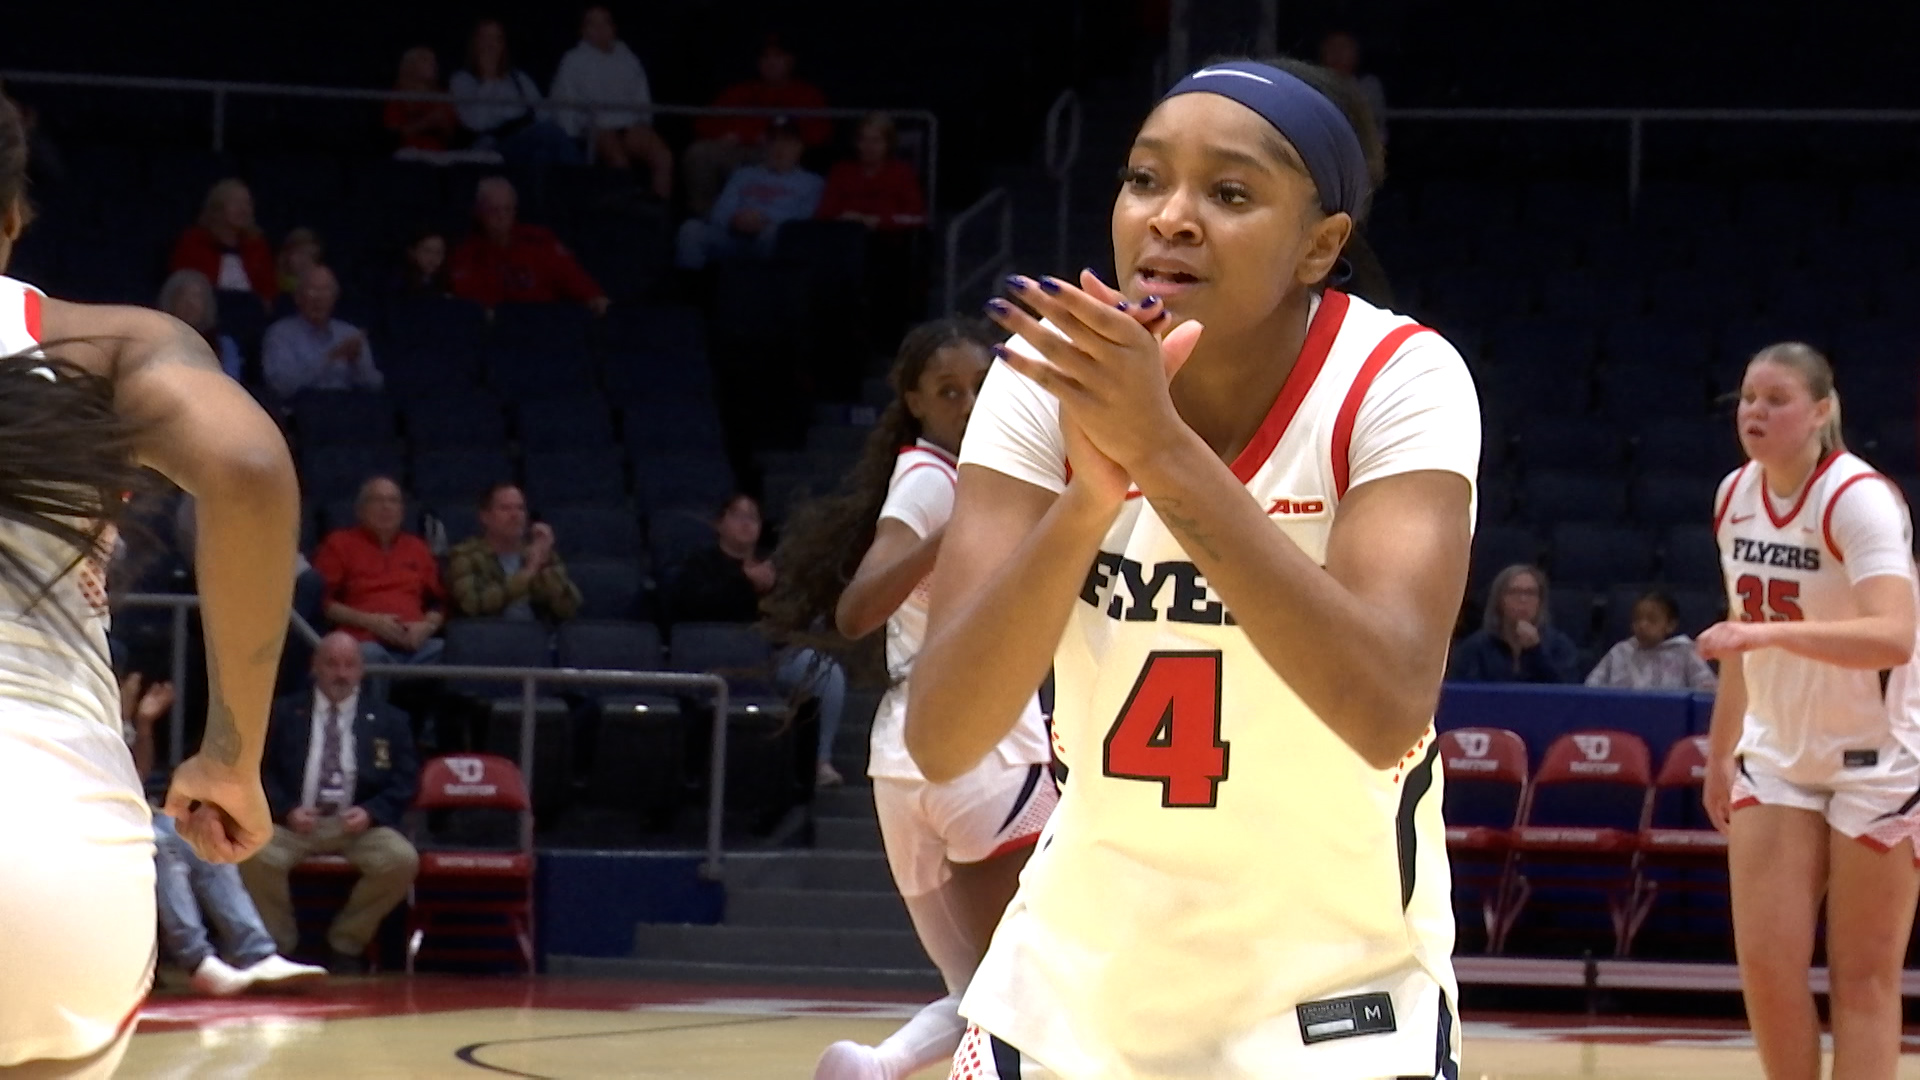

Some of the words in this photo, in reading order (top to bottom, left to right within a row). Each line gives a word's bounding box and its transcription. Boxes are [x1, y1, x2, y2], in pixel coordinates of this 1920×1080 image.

[1733, 538, 1820, 571] FLYERS
[1080, 549, 1239, 625] FYE
[1737, 574, 1804, 622] 35
[1103, 649, 1230, 808] 4
[1364, 1005, 1382, 1021] M
